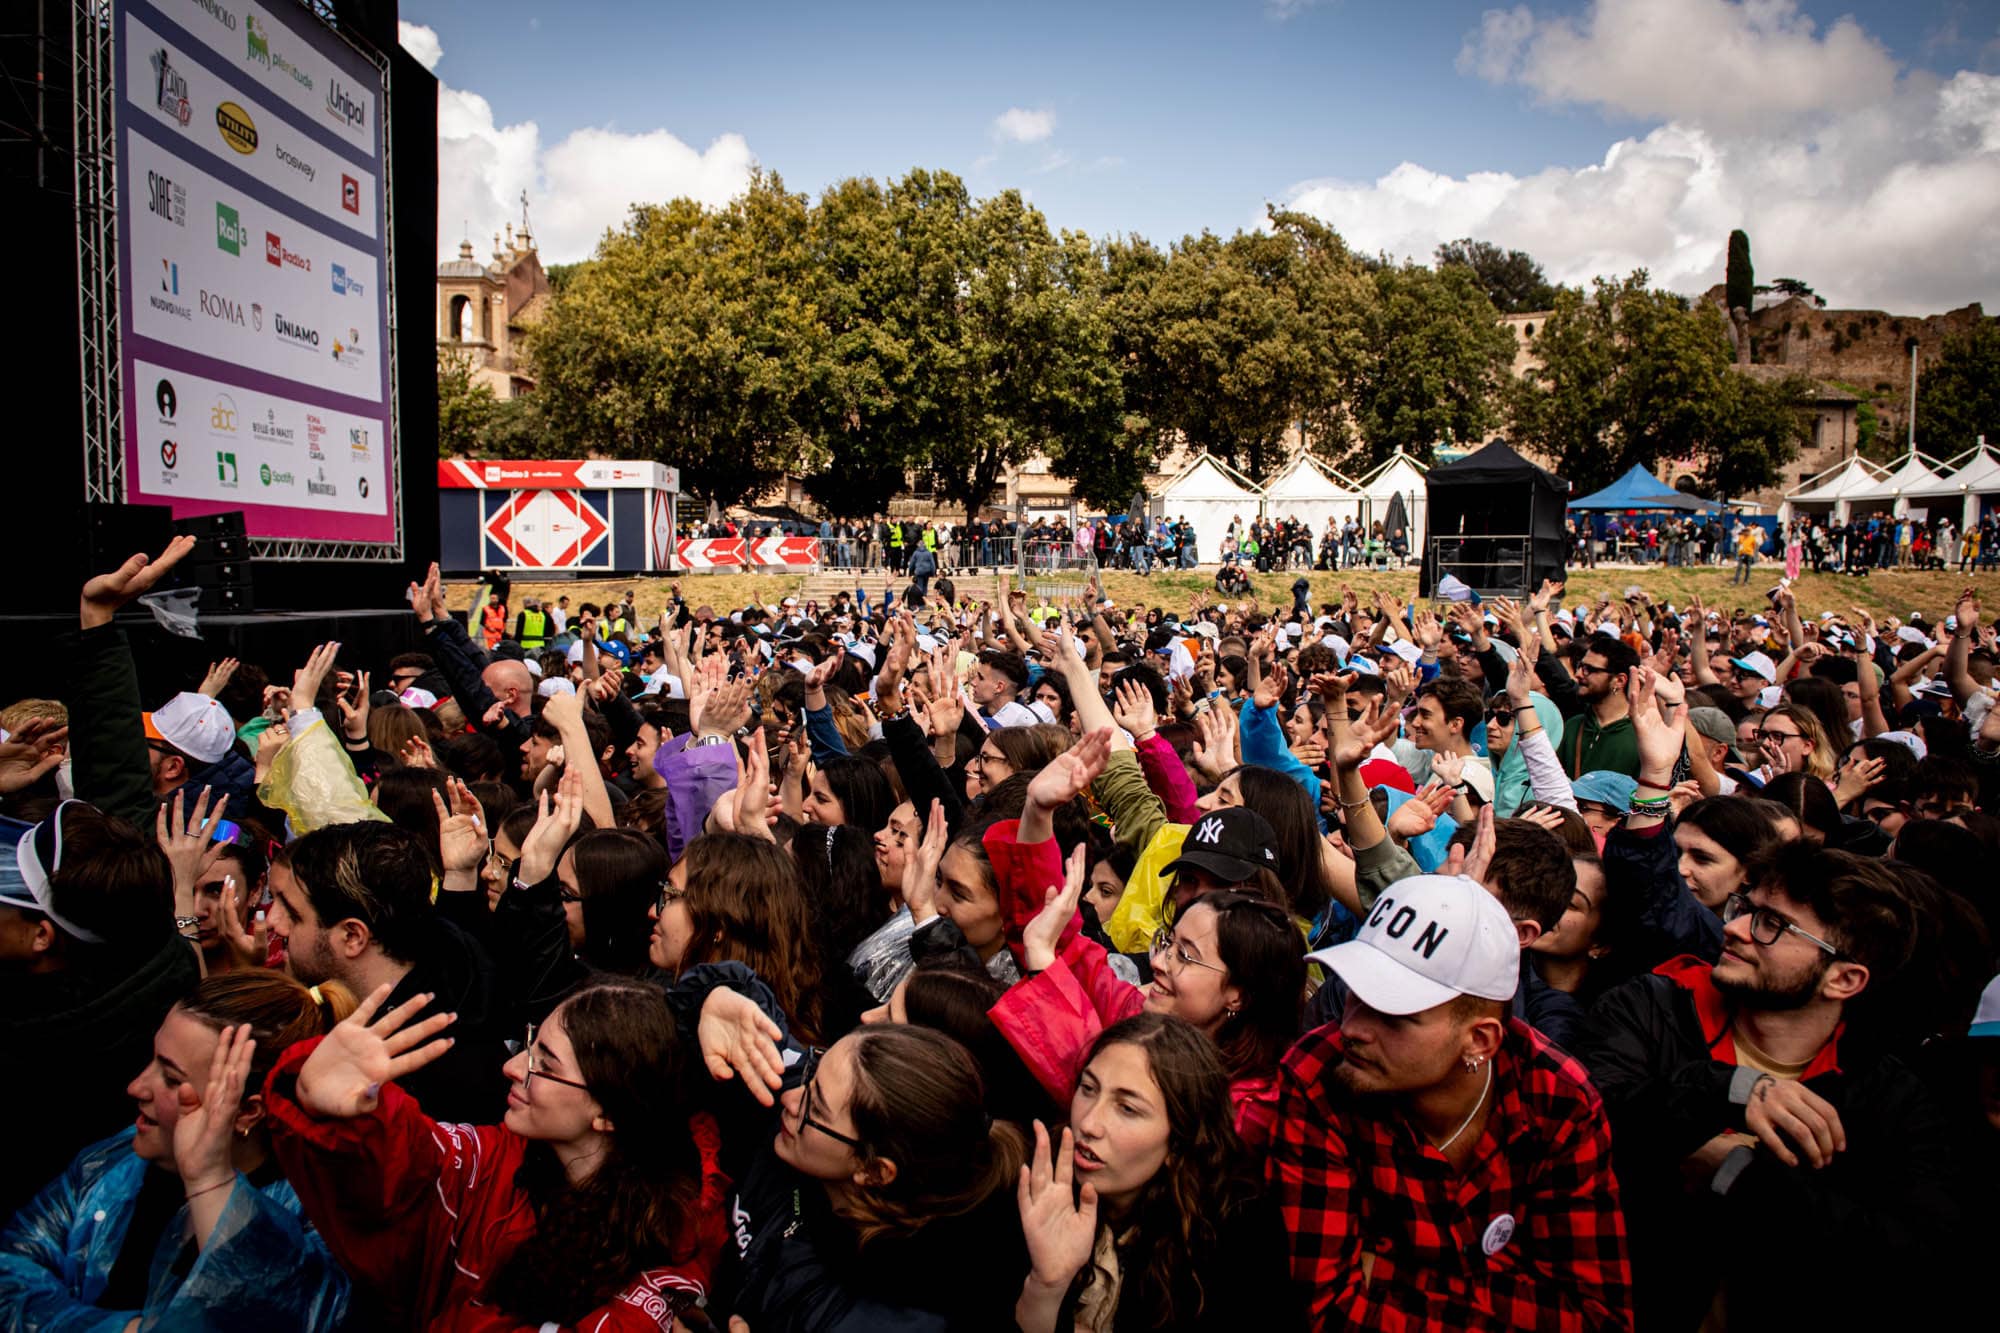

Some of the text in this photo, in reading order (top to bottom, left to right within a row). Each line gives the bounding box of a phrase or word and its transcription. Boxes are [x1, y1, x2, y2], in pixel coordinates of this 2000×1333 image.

[272, 52, 313, 91] plenitude
[329, 77, 364, 127] Unipol
[218, 110, 256, 144] UTILITY
[275, 143, 316, 183] brosway
[148, 169, 173, 222] SIAE
[219, 215, 248, 247] Rai 3
[266, 241, 312, 272] Rai Radio 2
[200, 288, 246, 328] ROMA
[272, 471, 295, 487] Spotify
